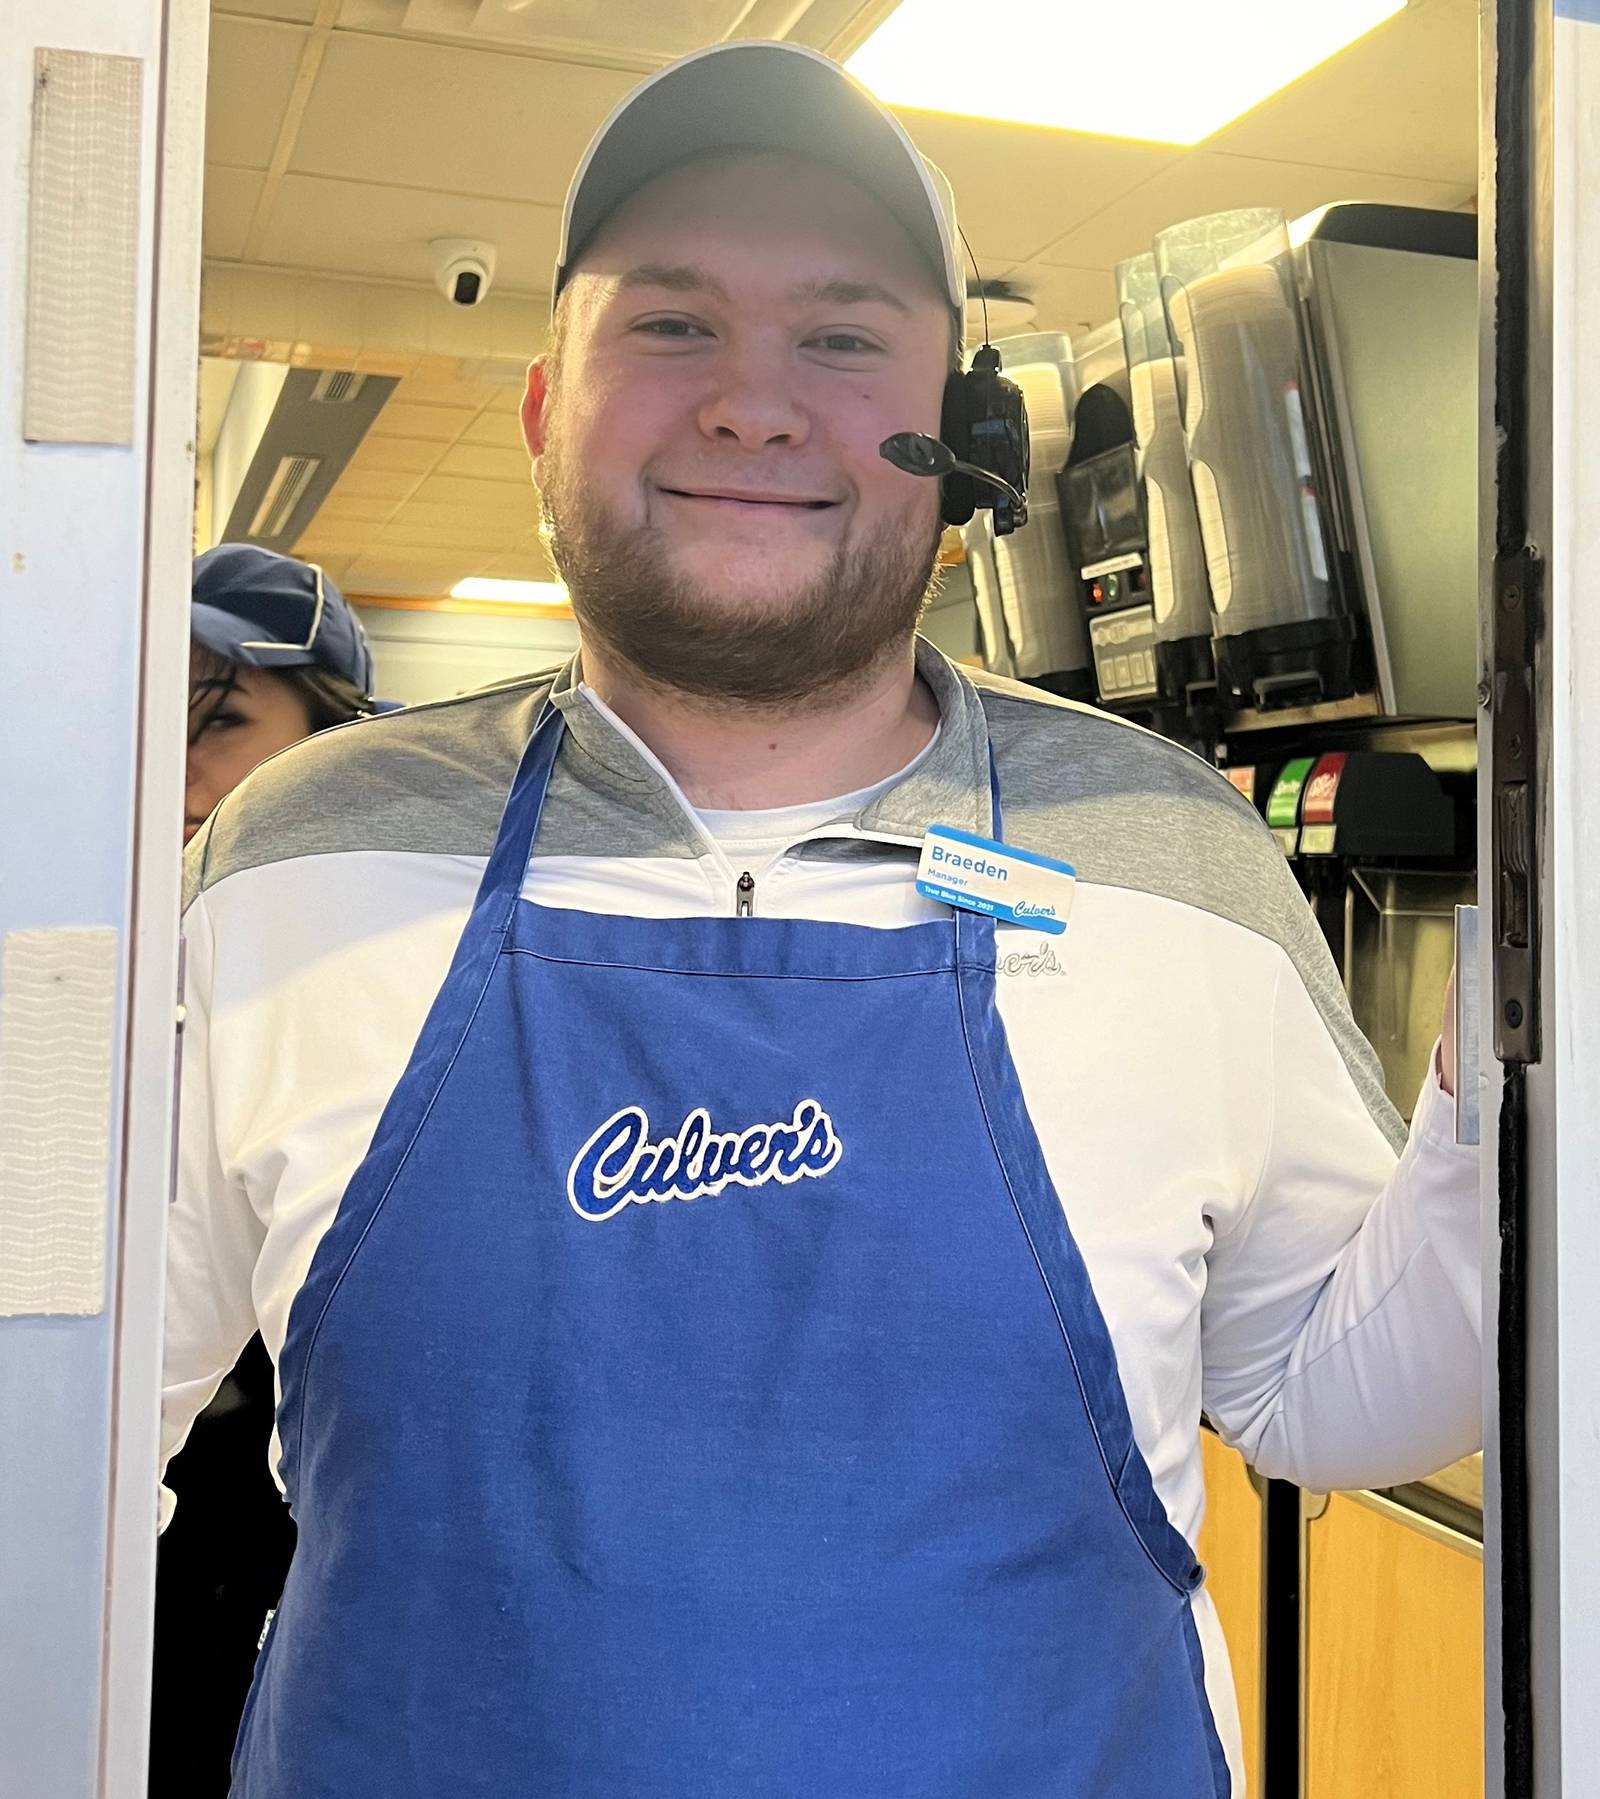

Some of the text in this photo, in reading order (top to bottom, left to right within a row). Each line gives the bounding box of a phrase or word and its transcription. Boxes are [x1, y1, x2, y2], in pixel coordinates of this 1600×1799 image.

[931, 846, 1009, 881] Braeden
[927, 868, 969, 887] Manager
[924, 885, 994, 912] True Blue Since 2021
[1014, 900, 1057, 916] Culver's
[566, 1098, 843, 1222] Culver's
